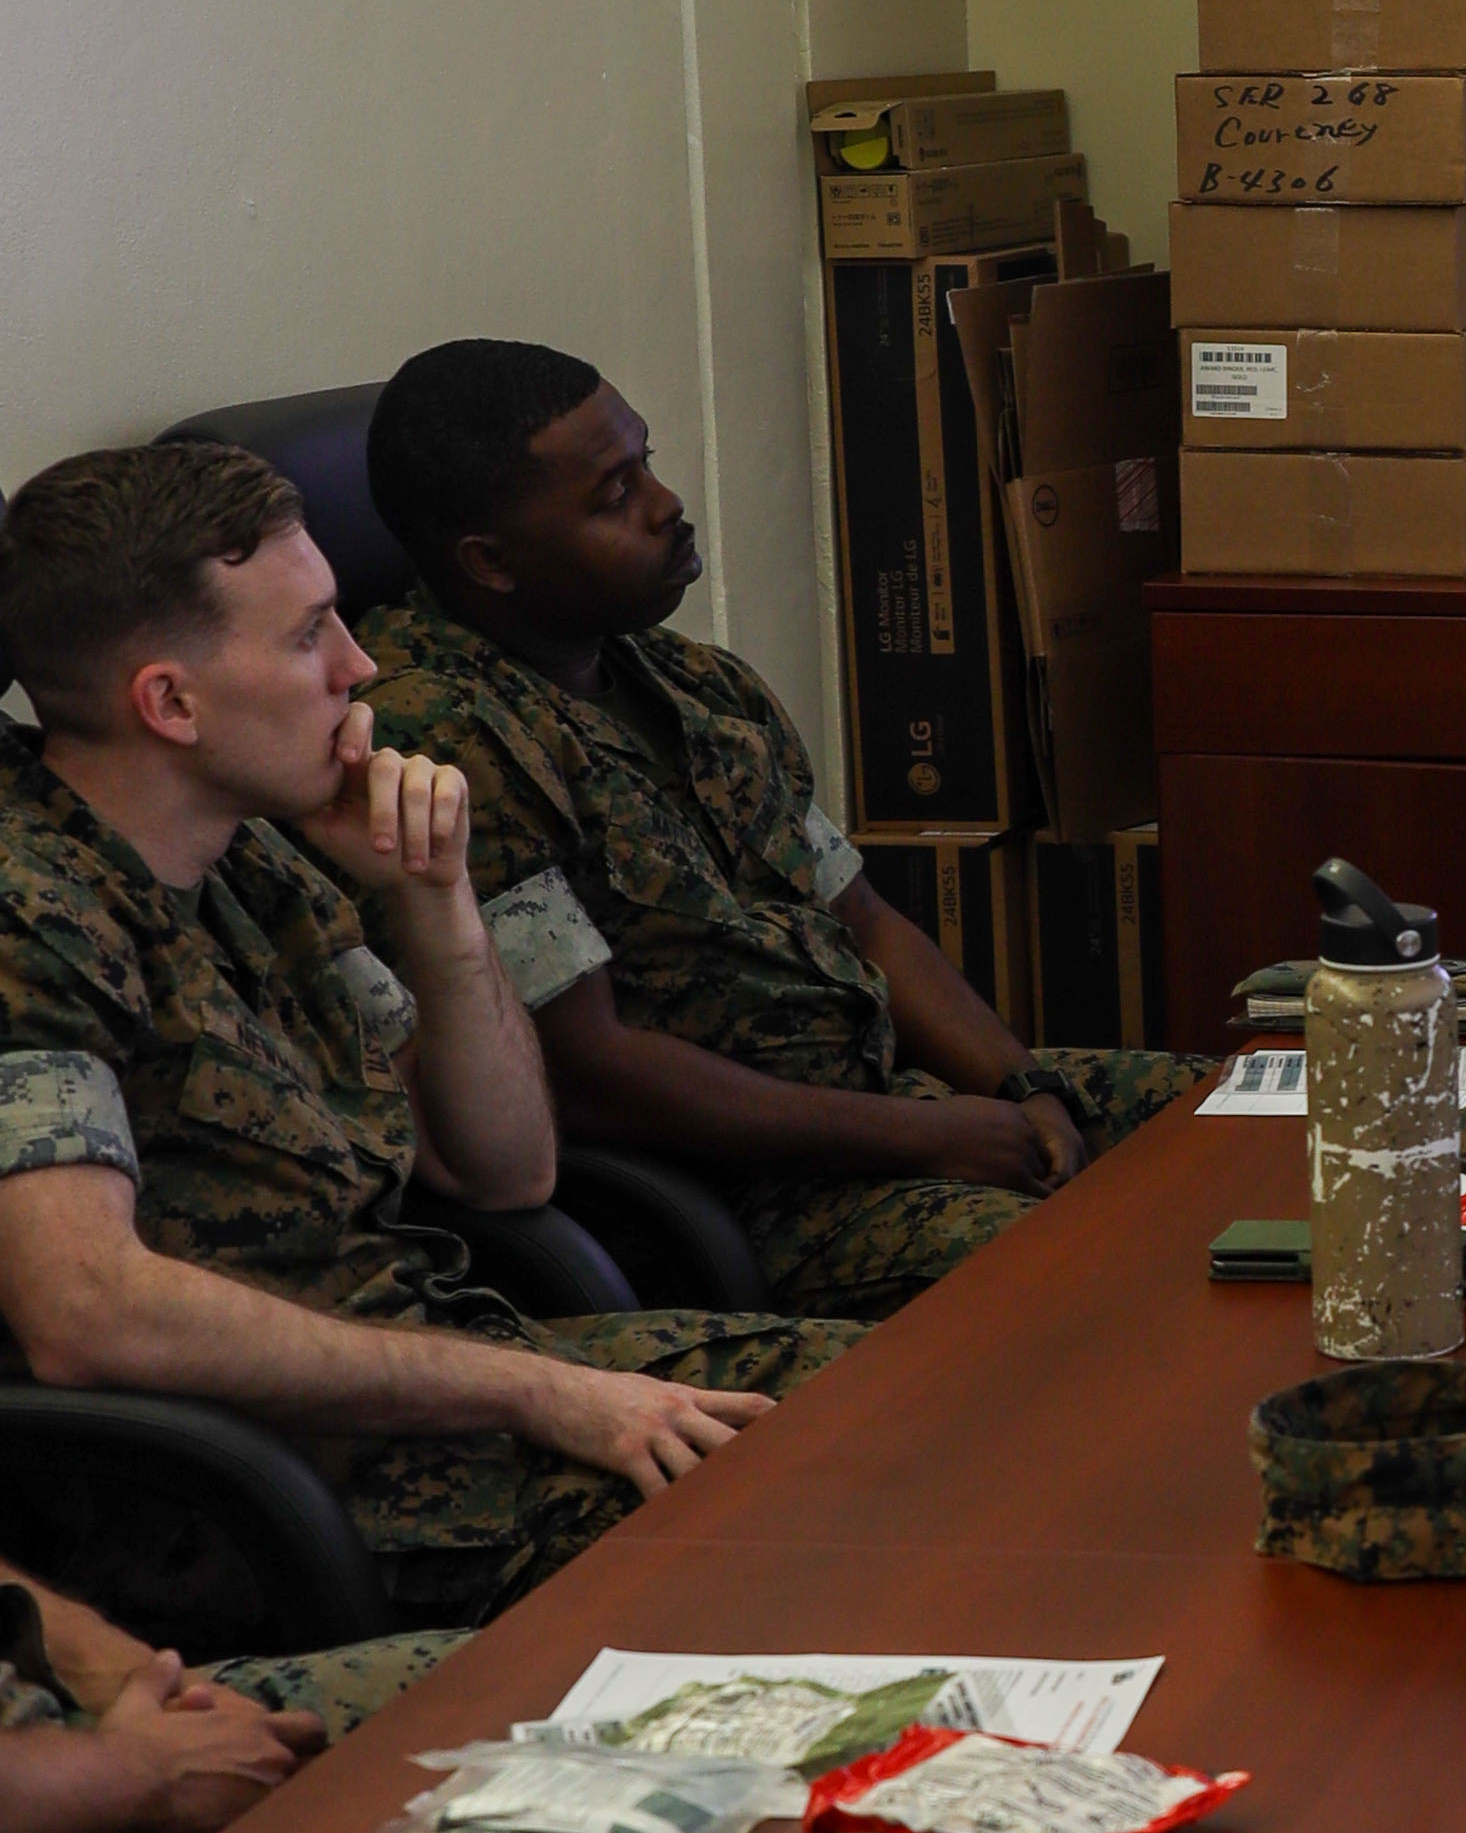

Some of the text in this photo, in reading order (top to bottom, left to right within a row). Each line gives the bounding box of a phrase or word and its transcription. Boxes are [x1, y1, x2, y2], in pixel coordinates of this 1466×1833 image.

[918, 274, 932, 336] 24BK55
[877, 571, 892, 653] LG Monitor
[890, 570, 907, 653] Monitor LG
[904, 540, 923, 653] Moniteur de LG
[910, 720, 933, 757] LG
[943, 865, 957, 926] 24BK55
[1121, 863, 1135, 924] 24BK55
